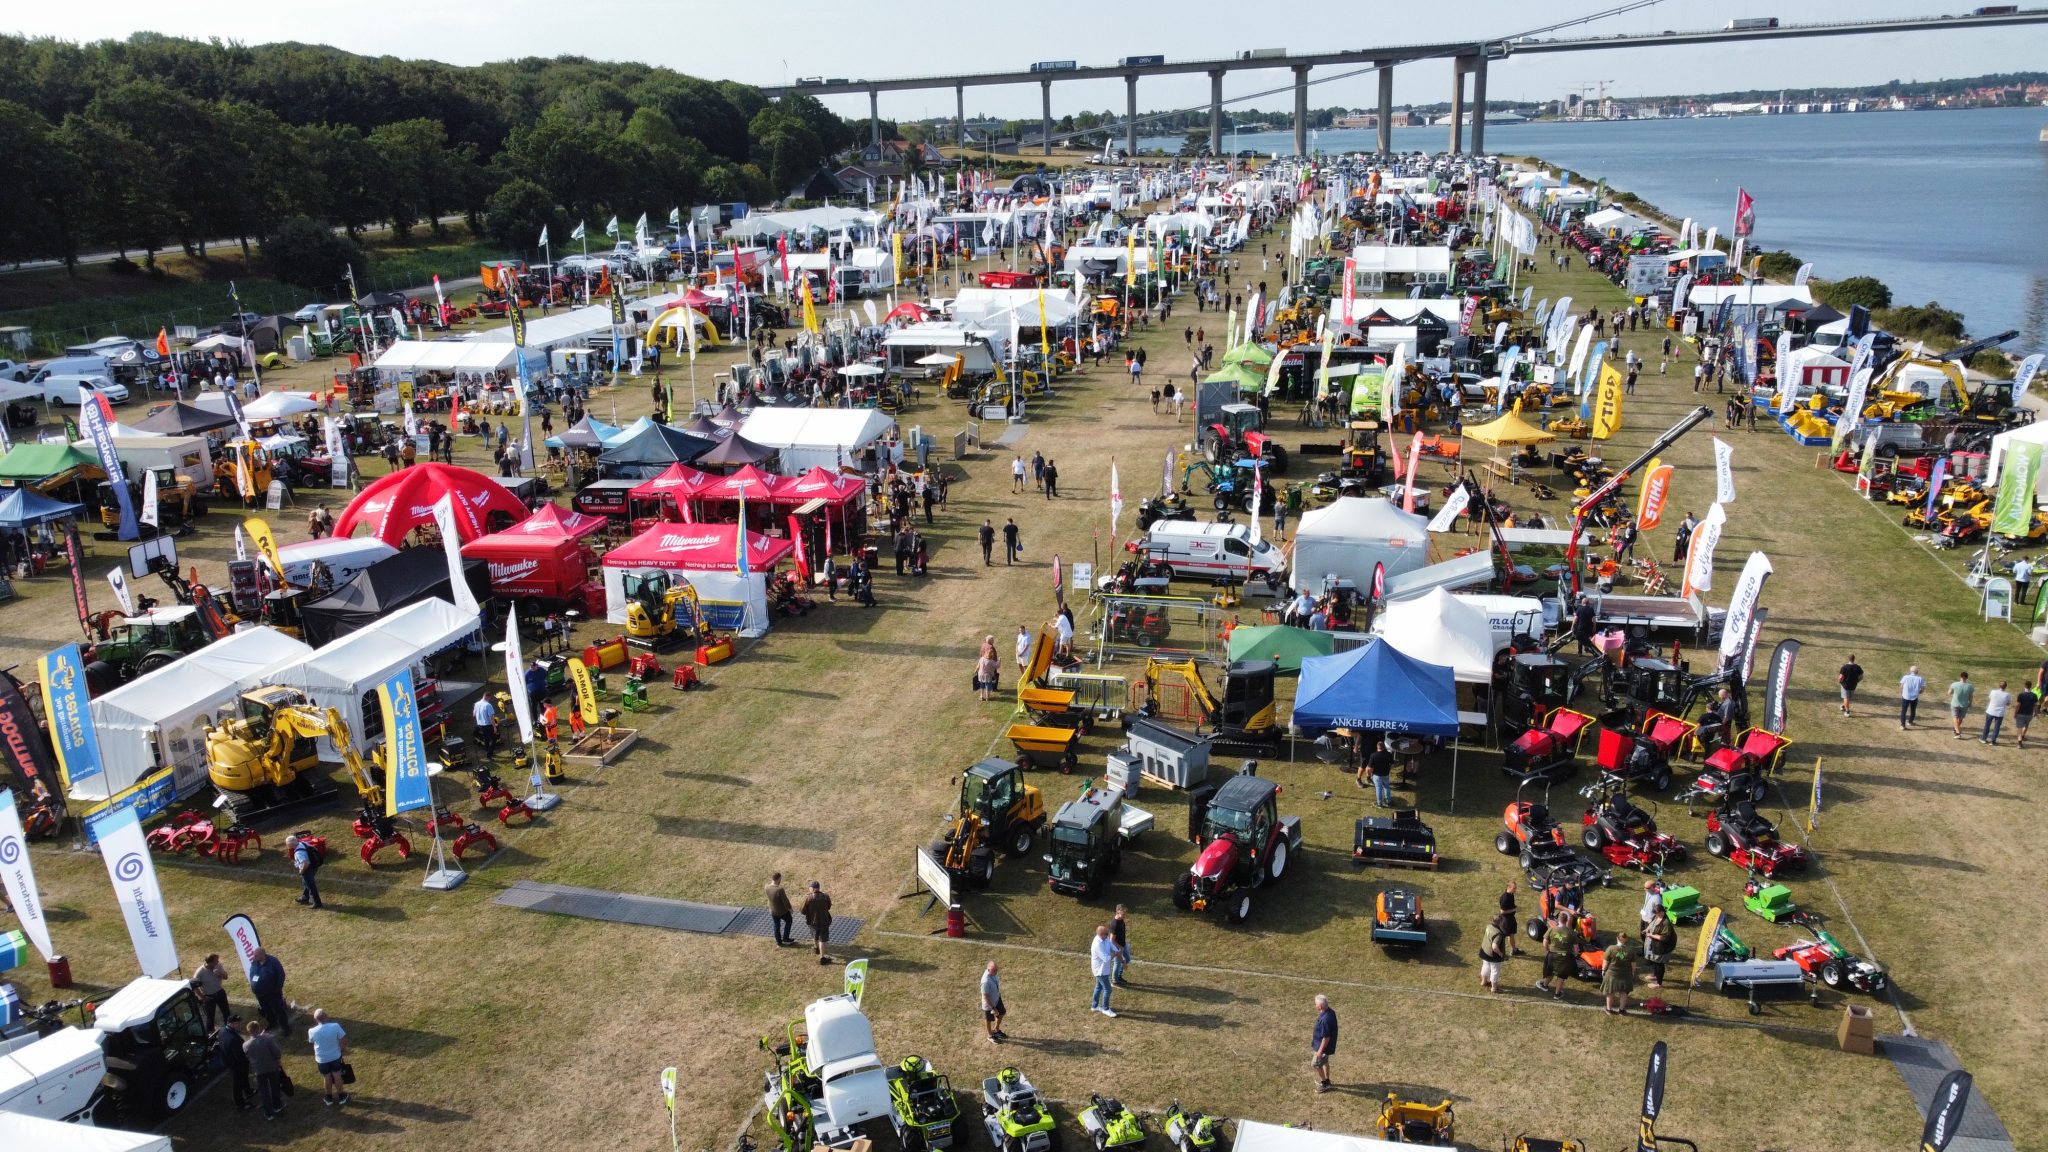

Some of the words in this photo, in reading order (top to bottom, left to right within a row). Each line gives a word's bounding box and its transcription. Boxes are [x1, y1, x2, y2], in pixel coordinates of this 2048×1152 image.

[1041, 62, 1055, 70] BLUE
[1056, 61, 1074, 69] WATER
[1601, 375, 1615, 432] STIGA
[1645, 478, 1664, 520] STIHL
[660, 534, 722, 547] Milwaukee
[487, 558, 539, 578] Milwaukee
[607, 559, 628, 567] Nothing
[1732, 576, 1756, 634] Hymaco
[1742, 619, 1760, 686] UROCOMACH
[1774, 648, 1790, 717] EUROCOMACH
[1331, 717, 1364, 729] ANKER
[1365, 720, 1397, 730] BJERRE
